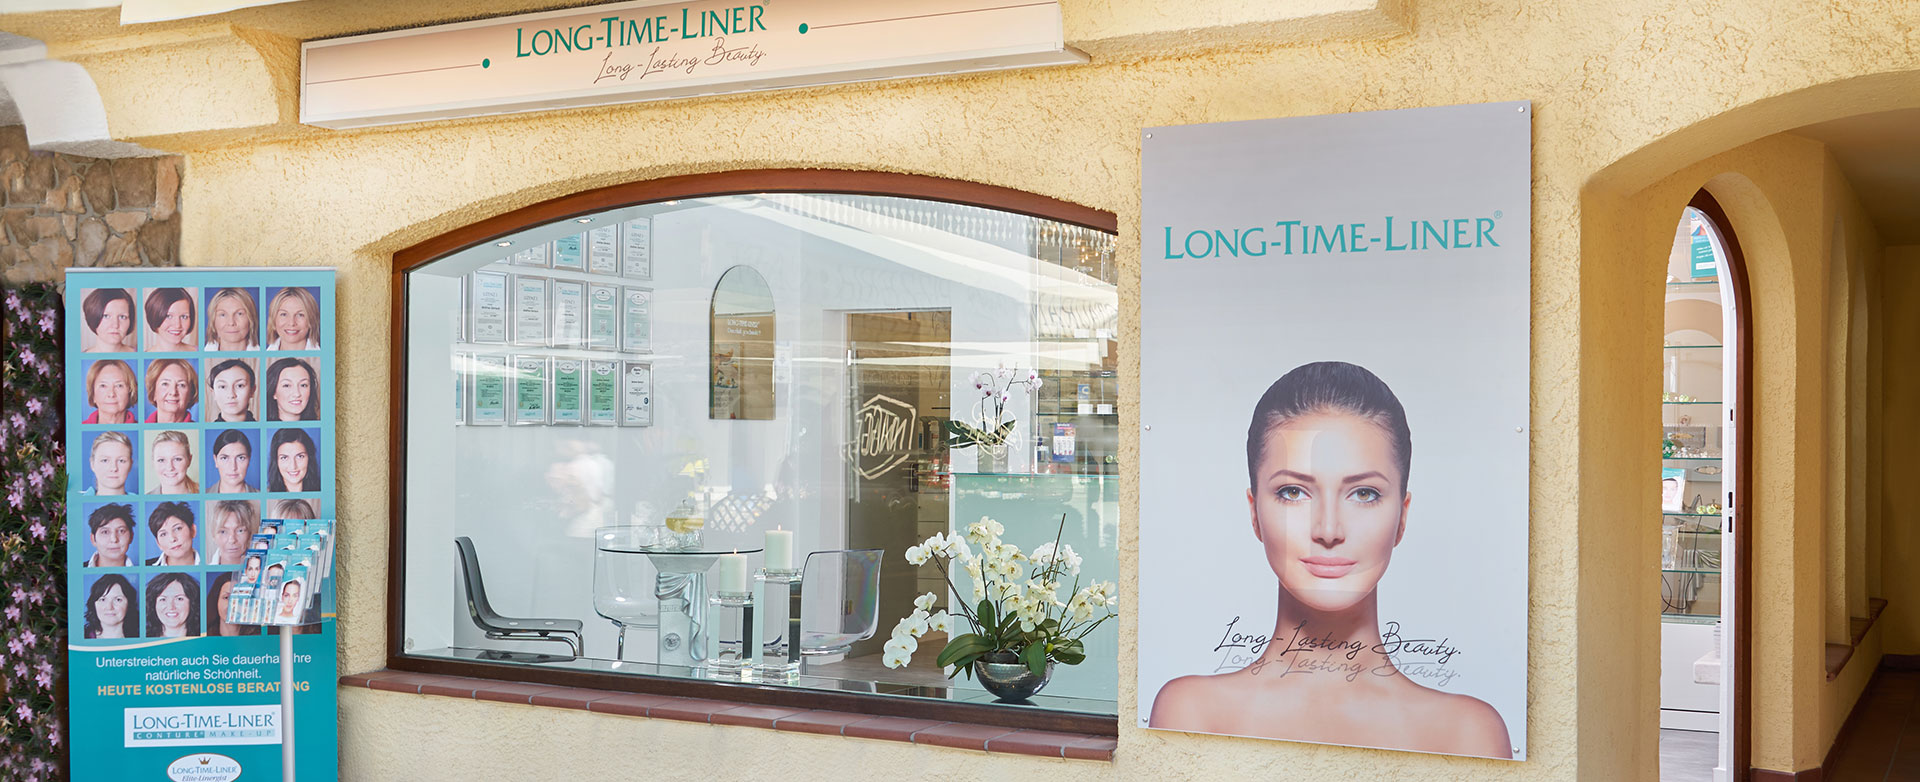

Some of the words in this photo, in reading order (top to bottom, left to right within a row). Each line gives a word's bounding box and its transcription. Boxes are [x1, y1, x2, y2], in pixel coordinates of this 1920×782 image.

[704, 36, 767, 67] Beauty.
[1372, 621, 1461, 664] Beauty.
[96, 655, 180, 668] Unterstreichen
[181, 655, 210, 666] auch
[212, 654, 230, 666] Sie
[232, 653, 280, 665] dauerha
[293, 652, 312, 663] hre
[145, 669, 200, 681] natürliche
[203, 668, 262, 680] Schönheit.
[97, 685, 142, 696] HEUTE
[146, 683, 233, 695] KOSTENLOSE
[237, 681, 310, 693] BERATNG
